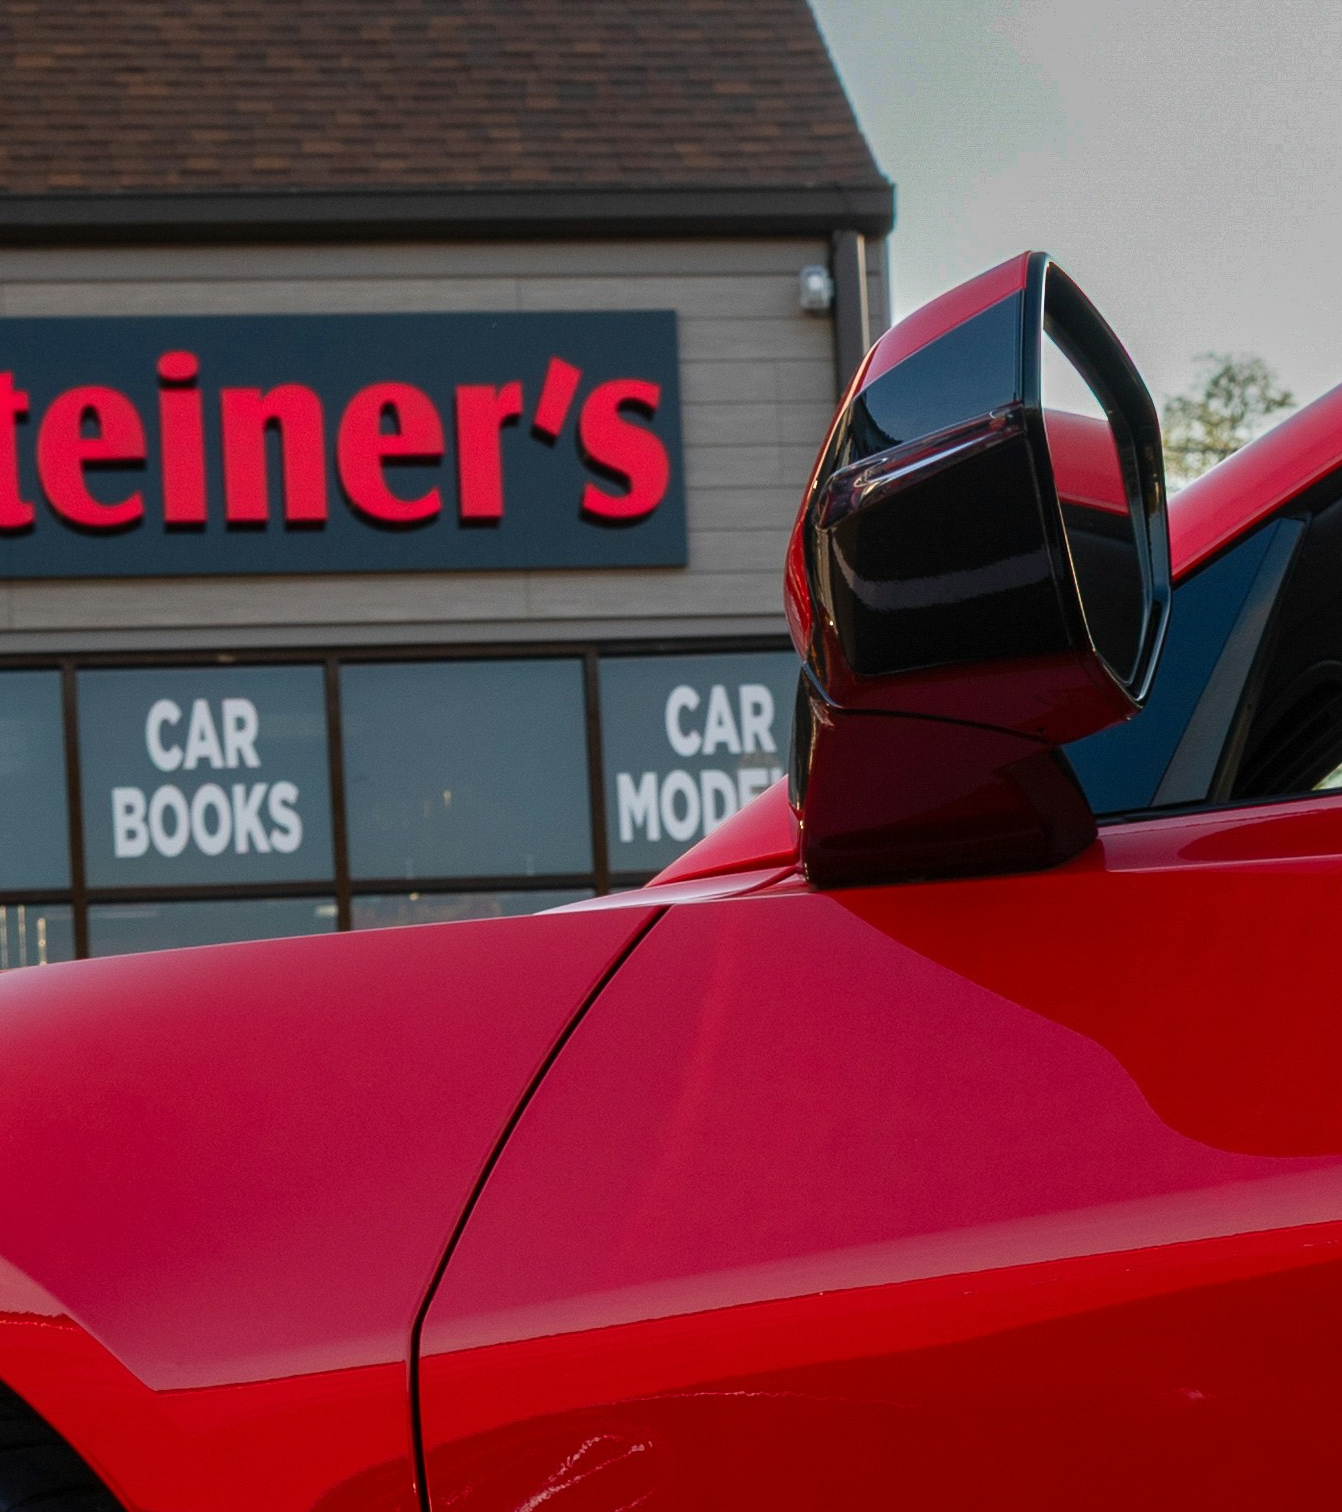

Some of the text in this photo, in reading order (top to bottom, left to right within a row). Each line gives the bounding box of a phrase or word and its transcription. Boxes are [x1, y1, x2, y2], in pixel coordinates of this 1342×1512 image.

[145, 697, 261, 772] CAR
[665, 684, 777, 757] CAR
[111, 781, 303, 859] BOOKS
[616, 767, 783, 842] MODE
